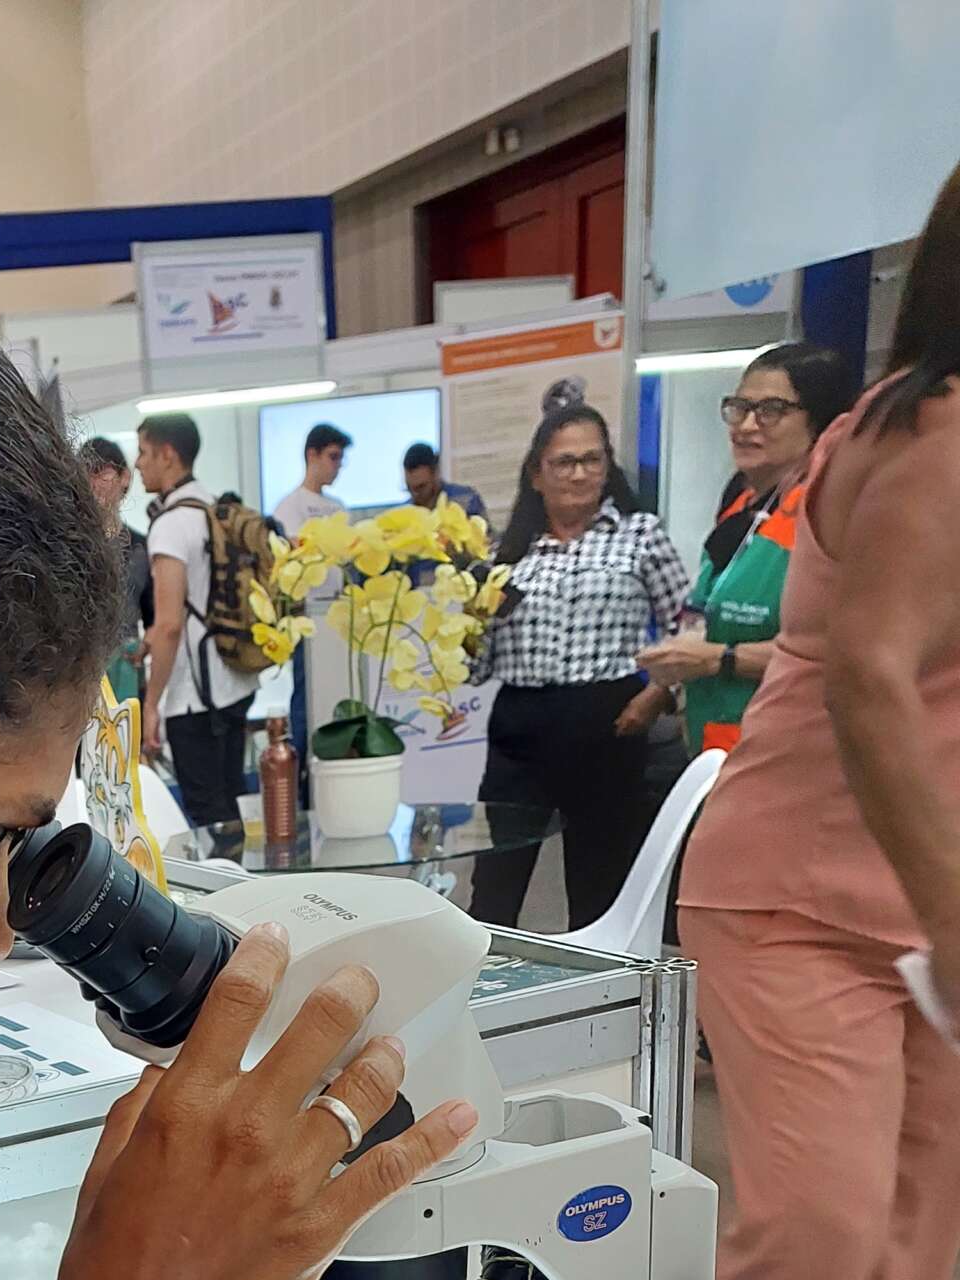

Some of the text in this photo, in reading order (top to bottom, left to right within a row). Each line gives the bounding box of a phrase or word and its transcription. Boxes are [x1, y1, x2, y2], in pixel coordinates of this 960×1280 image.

[303, 893, 359, 921] OLYMPUS
[565, 1193, 625, 1217] OLYMPUS
[583, 1211, 608, 1232] SZ
